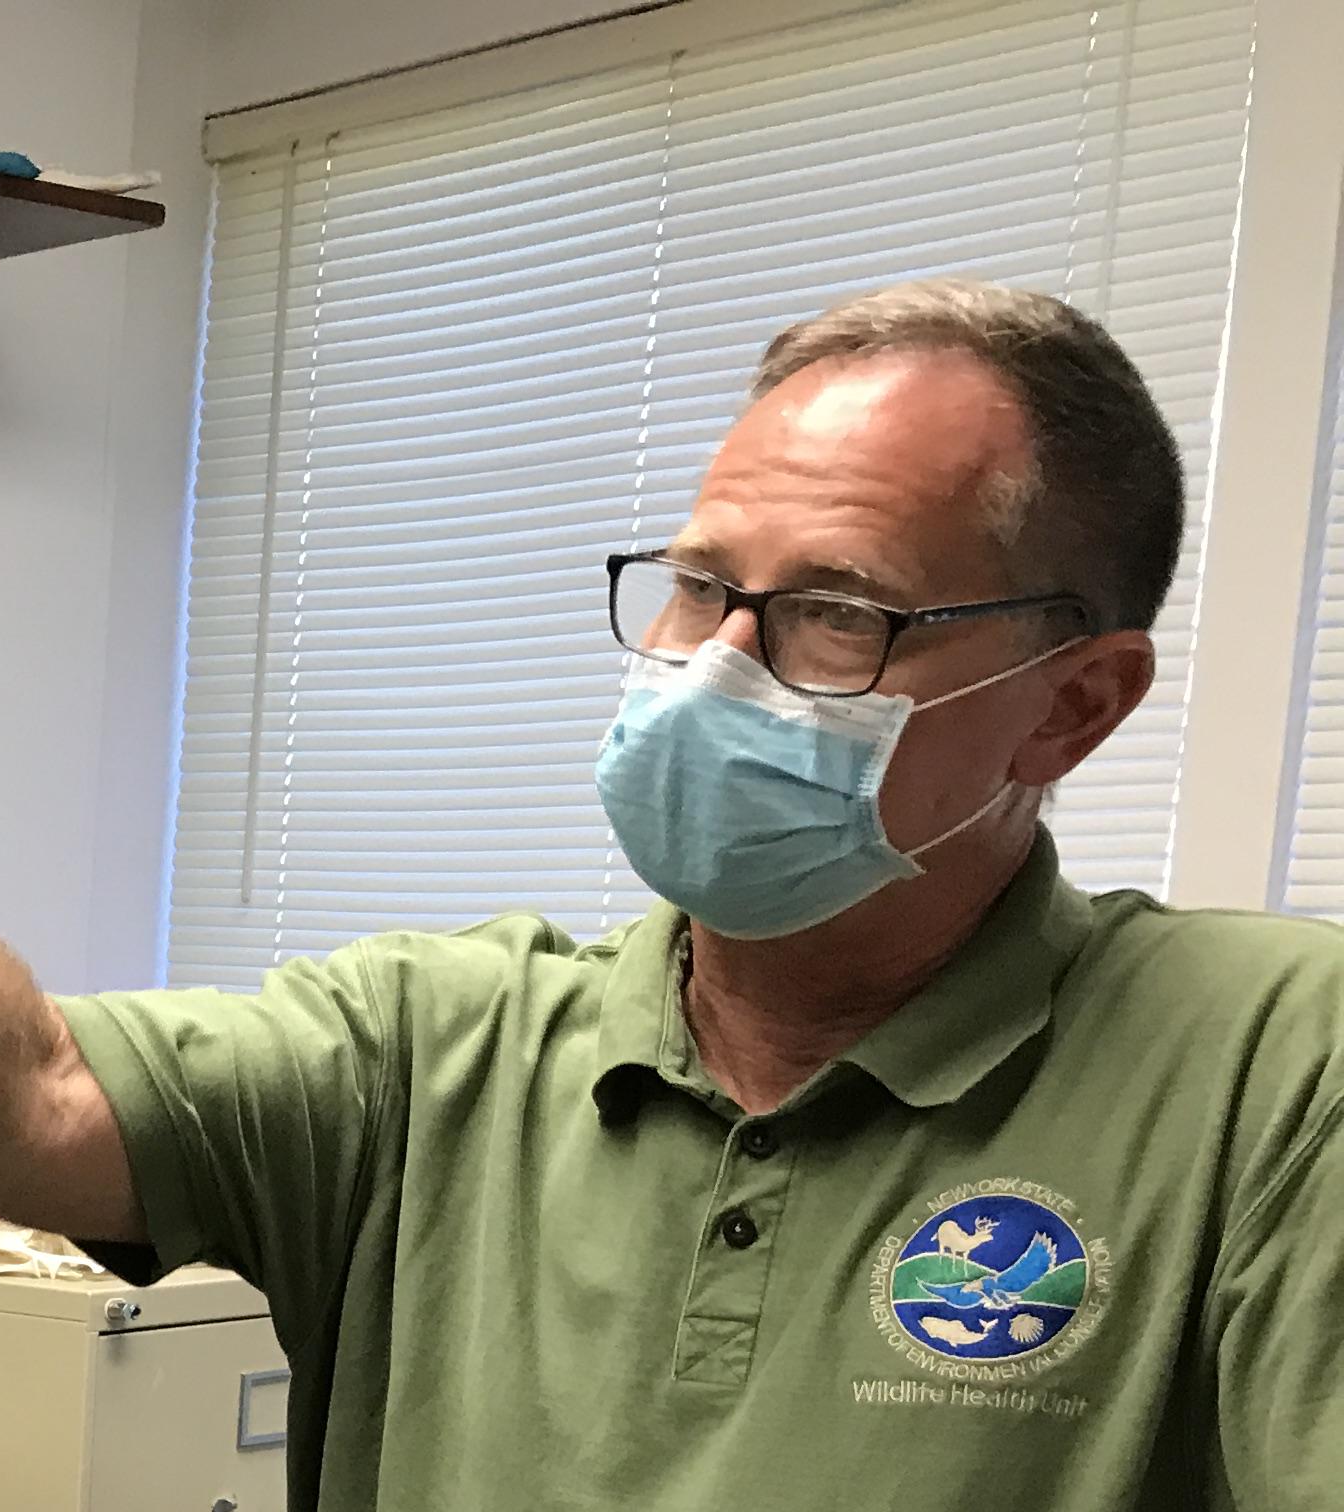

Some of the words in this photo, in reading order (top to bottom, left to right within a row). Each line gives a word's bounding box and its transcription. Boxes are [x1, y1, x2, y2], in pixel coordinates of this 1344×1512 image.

[926, 1183, 967, 1213] NEW
[966, 1177, 1020, 1195] YORK
[1019, 1180, 1076, 1212] STATE
[869, 1235, 901, 1335] DEPARTMENT
[887, 1332, 910, 1352] OF
[853, 1380, 944, 1403] Wildlife
